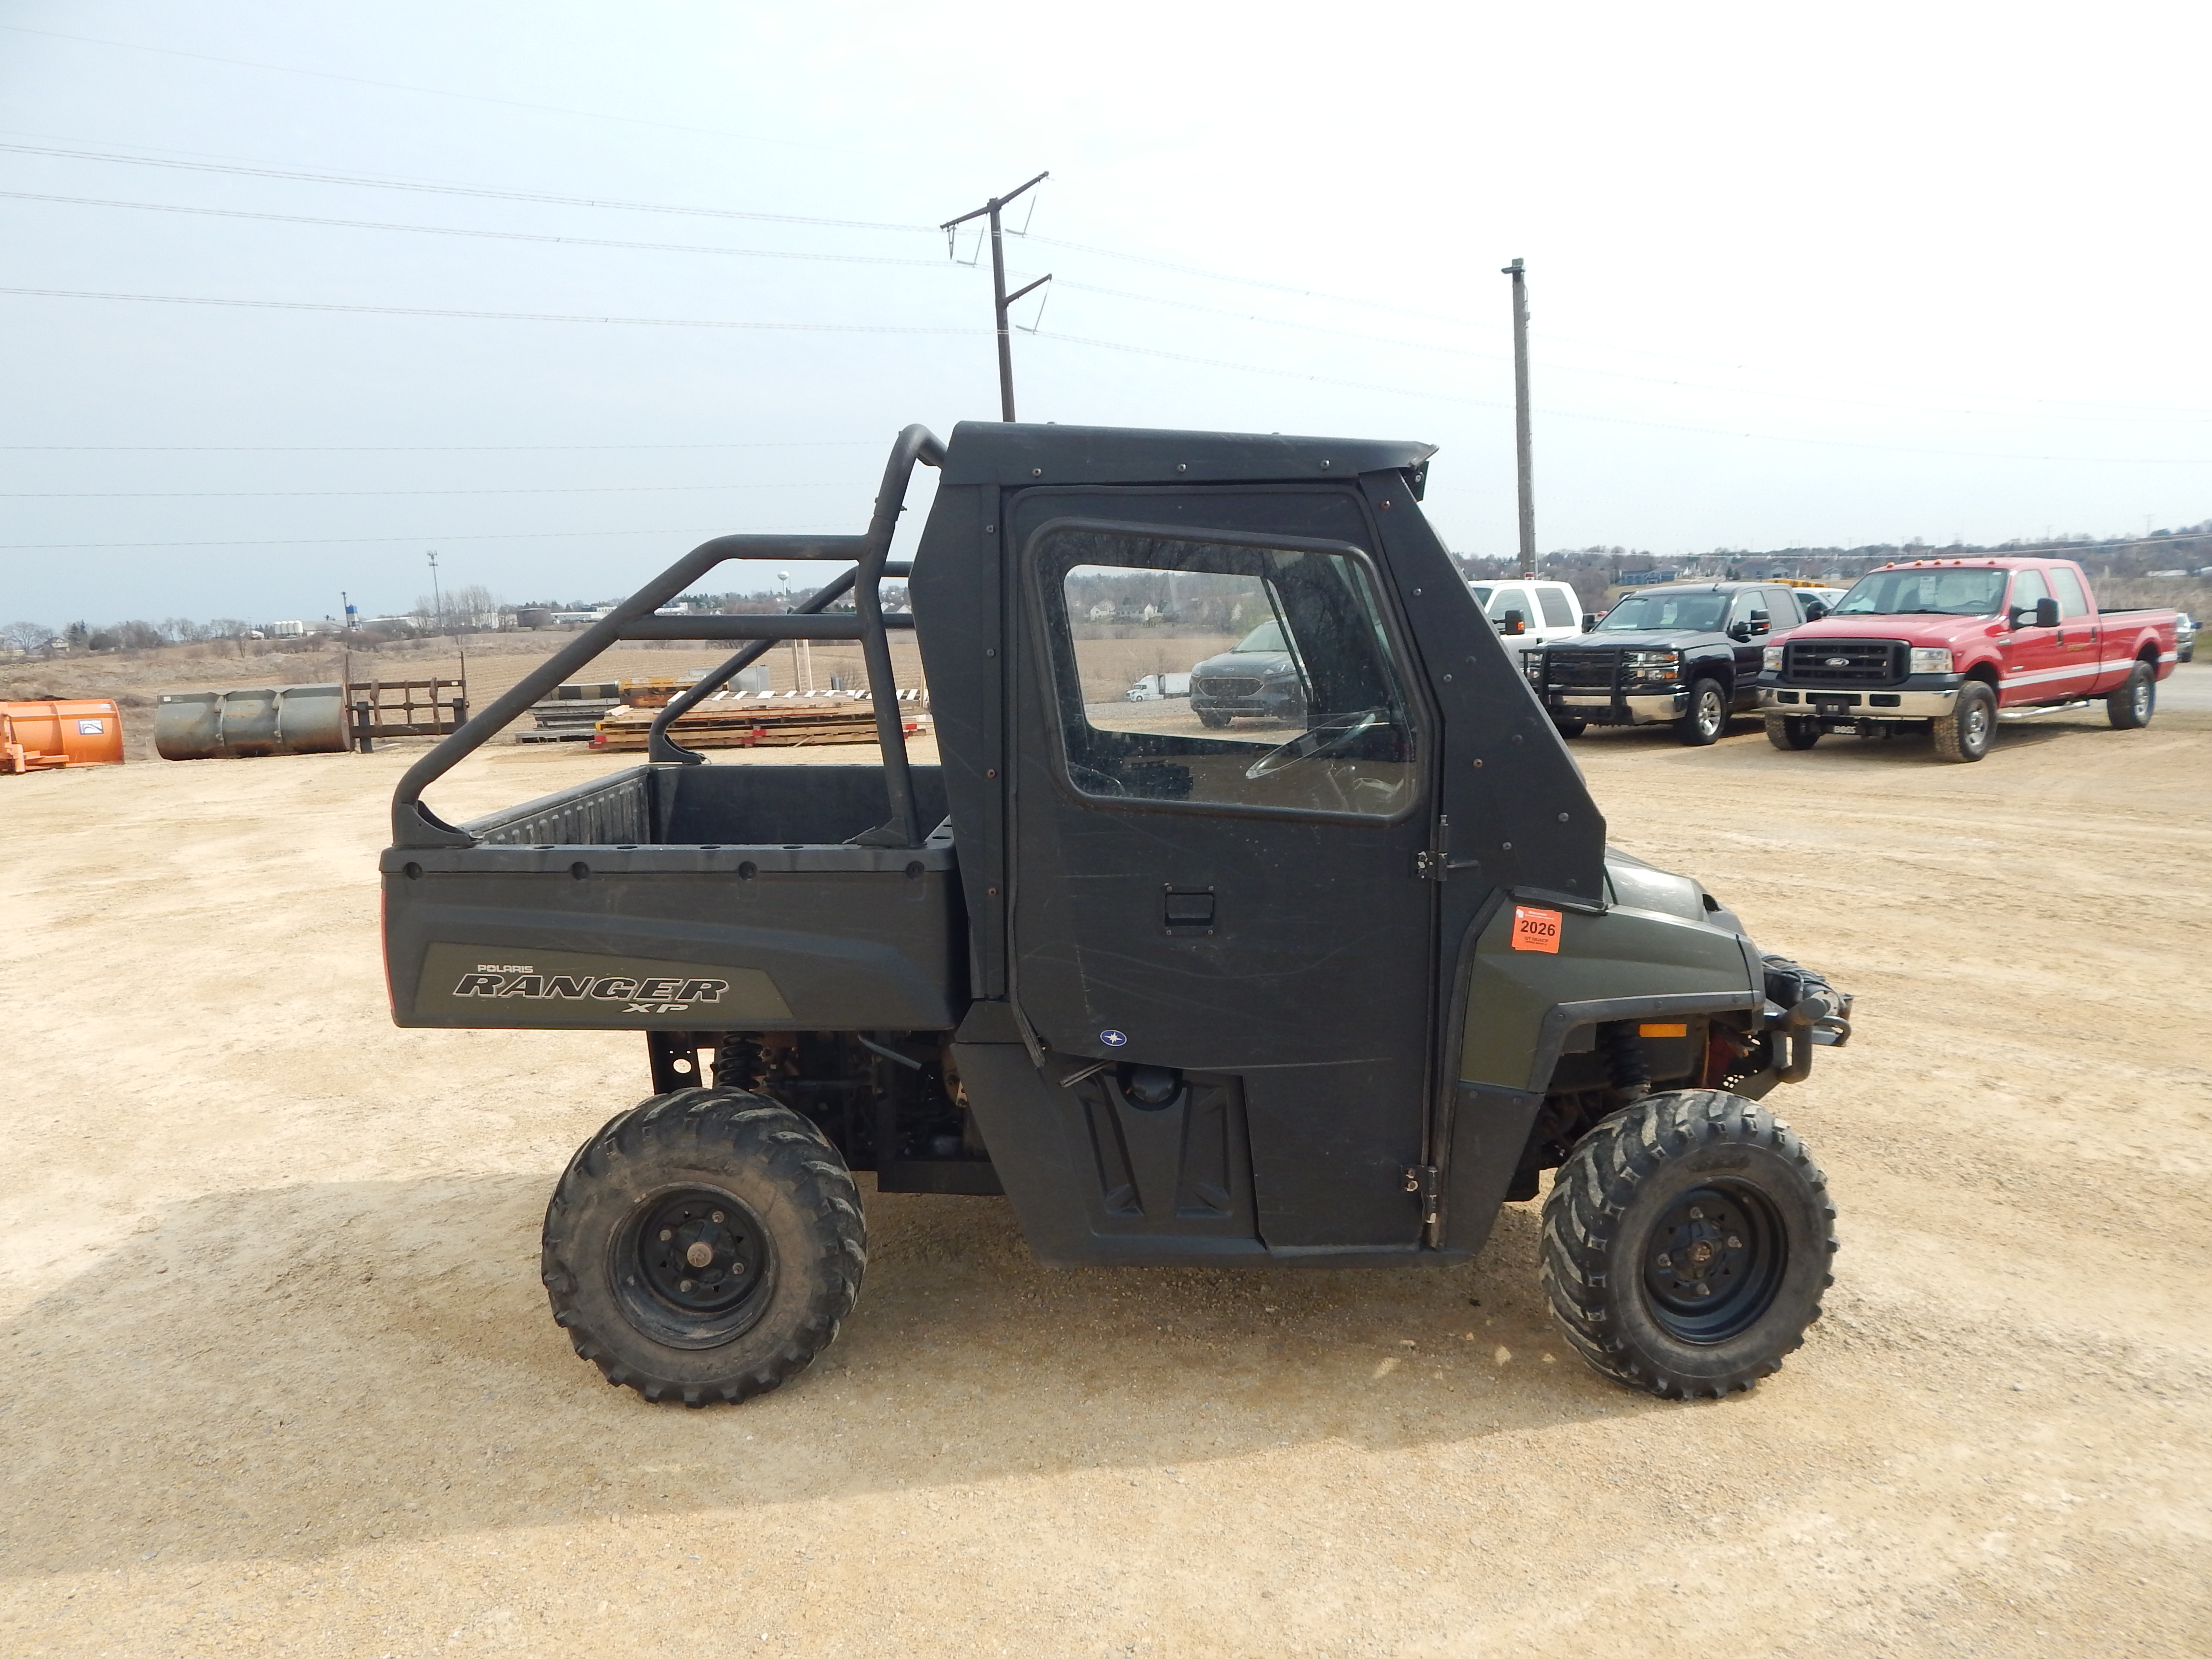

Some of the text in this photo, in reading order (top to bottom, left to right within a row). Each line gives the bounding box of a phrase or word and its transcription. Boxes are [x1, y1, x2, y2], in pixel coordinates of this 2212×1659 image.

[1520, 920, 1555, 936] 2026
[478, 964, 533, 973] POLARIS
[452, 973, 730, 1003] RANGER
[622, 1003, 689, 1013] XP
